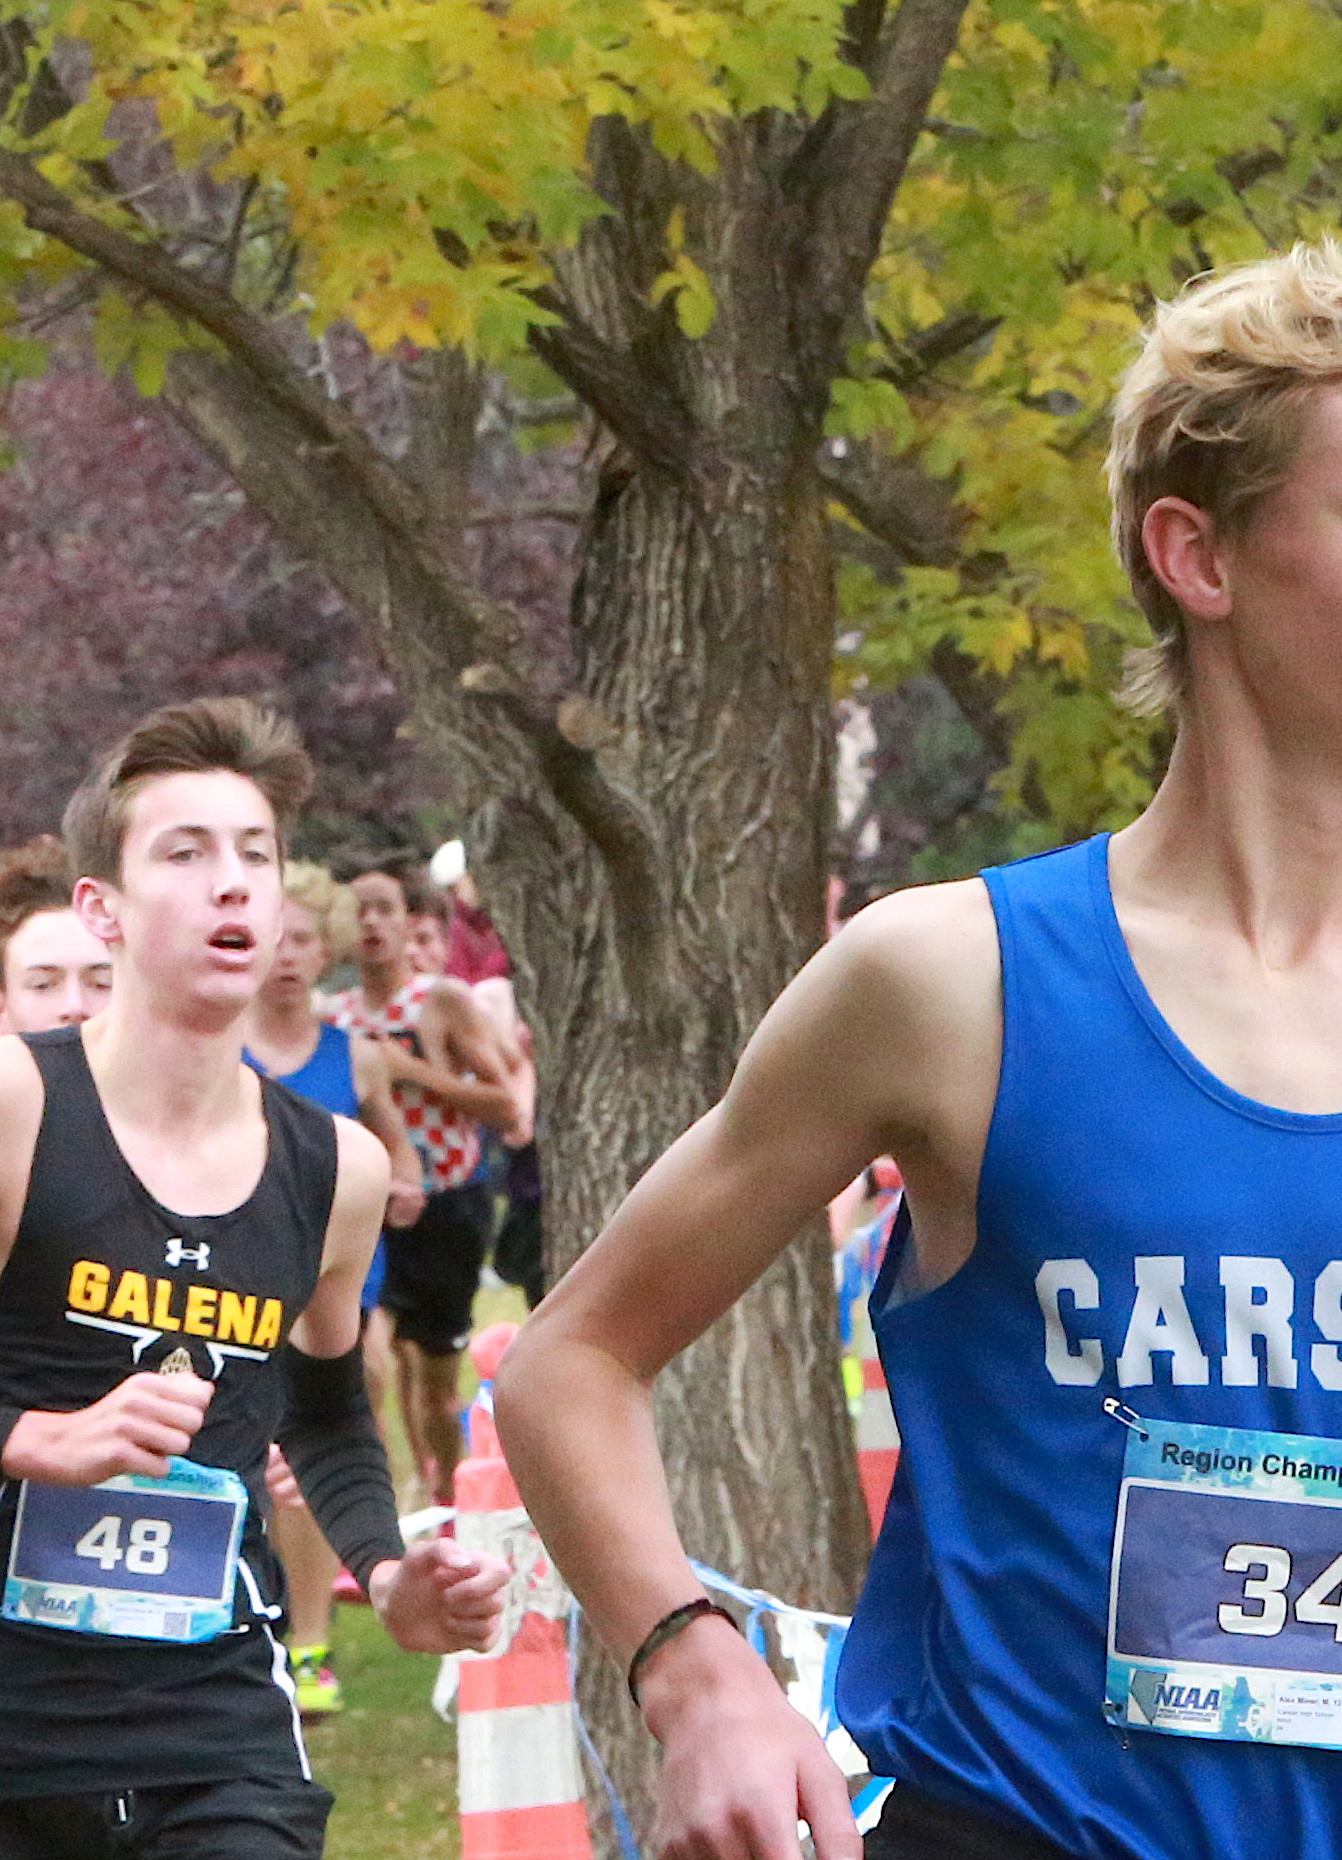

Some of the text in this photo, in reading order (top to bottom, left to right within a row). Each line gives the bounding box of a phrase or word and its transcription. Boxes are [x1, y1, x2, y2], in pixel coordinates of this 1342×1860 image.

[67, 1258, 284, 1349] GALENA
[1161, 1442, 1252, 1474] Region
[75, 1514, 173, 1576] 48
[1154, 1684, 1221, 1710] NIAA
